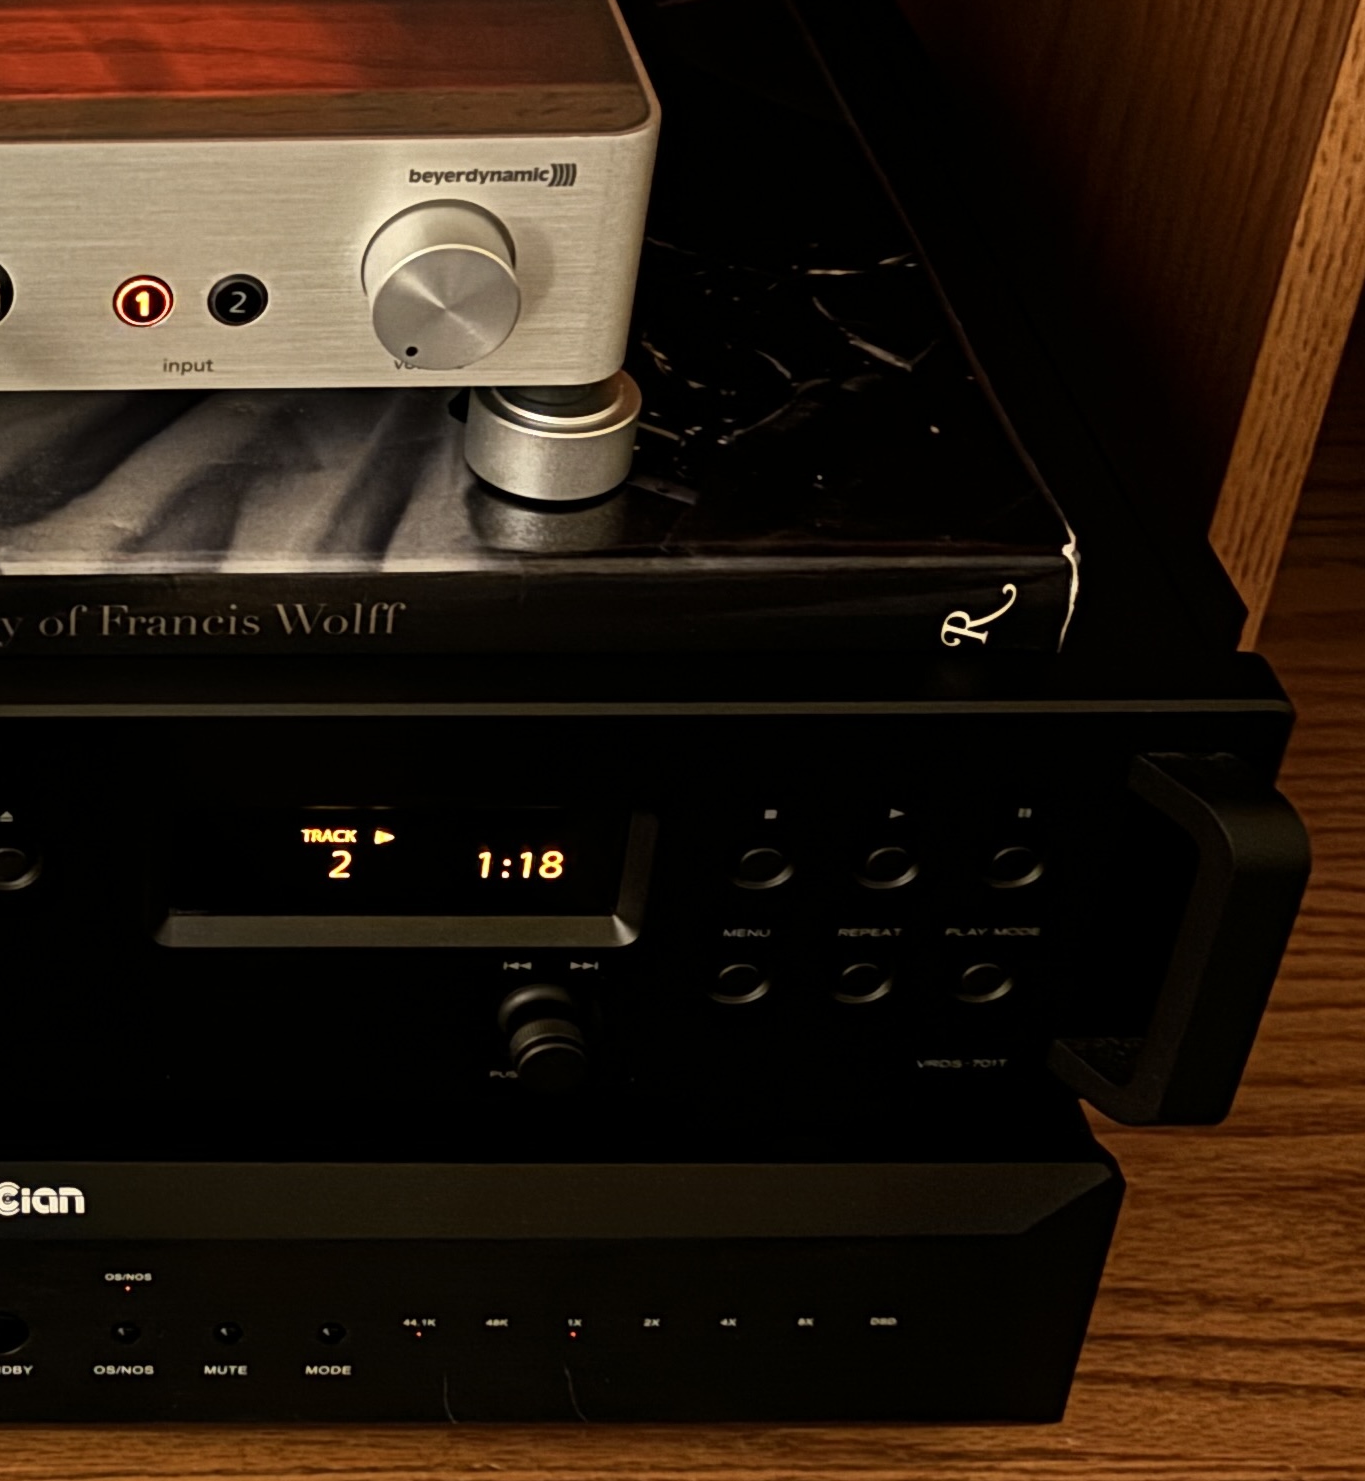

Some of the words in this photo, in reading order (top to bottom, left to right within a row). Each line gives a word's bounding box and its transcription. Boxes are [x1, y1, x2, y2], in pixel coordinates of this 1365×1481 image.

[408, 166, 550, 185] beyerdynamic
[134, 291, 150, 318] 1
[228, 291, 248, 314] 2
[162, 358, 214, 375] input
[38, 604, 88, 638] of
[100, 604, 261, 638] Francis
[272, 602, 406, 636] Wolff
[300, 829, 357, 843] TRACK
[328, 851, 352, 879] 2
[477, 851, 564, 879] 1:18
[723, 928, 771, 937] MENU
[838, 928, 903, 937] REPEAT
[945, 927, 988, 936] PLAY
[993, 927, 1040, 936] MODE
[489, 1070, 519, 1079] PUS
[104, 1272, 152, 1282] OS/NOS
[485, 1318, 509, 1328] 48K
[643, 1318, 661, 1328] 2X
[720, 1317, 737, 1327] 4X
[93, 1364, 155, 1376] OS/NOS
[204, 1364, 248, 1376] MUTE
[305, 1364, 352, 1376] MODE
